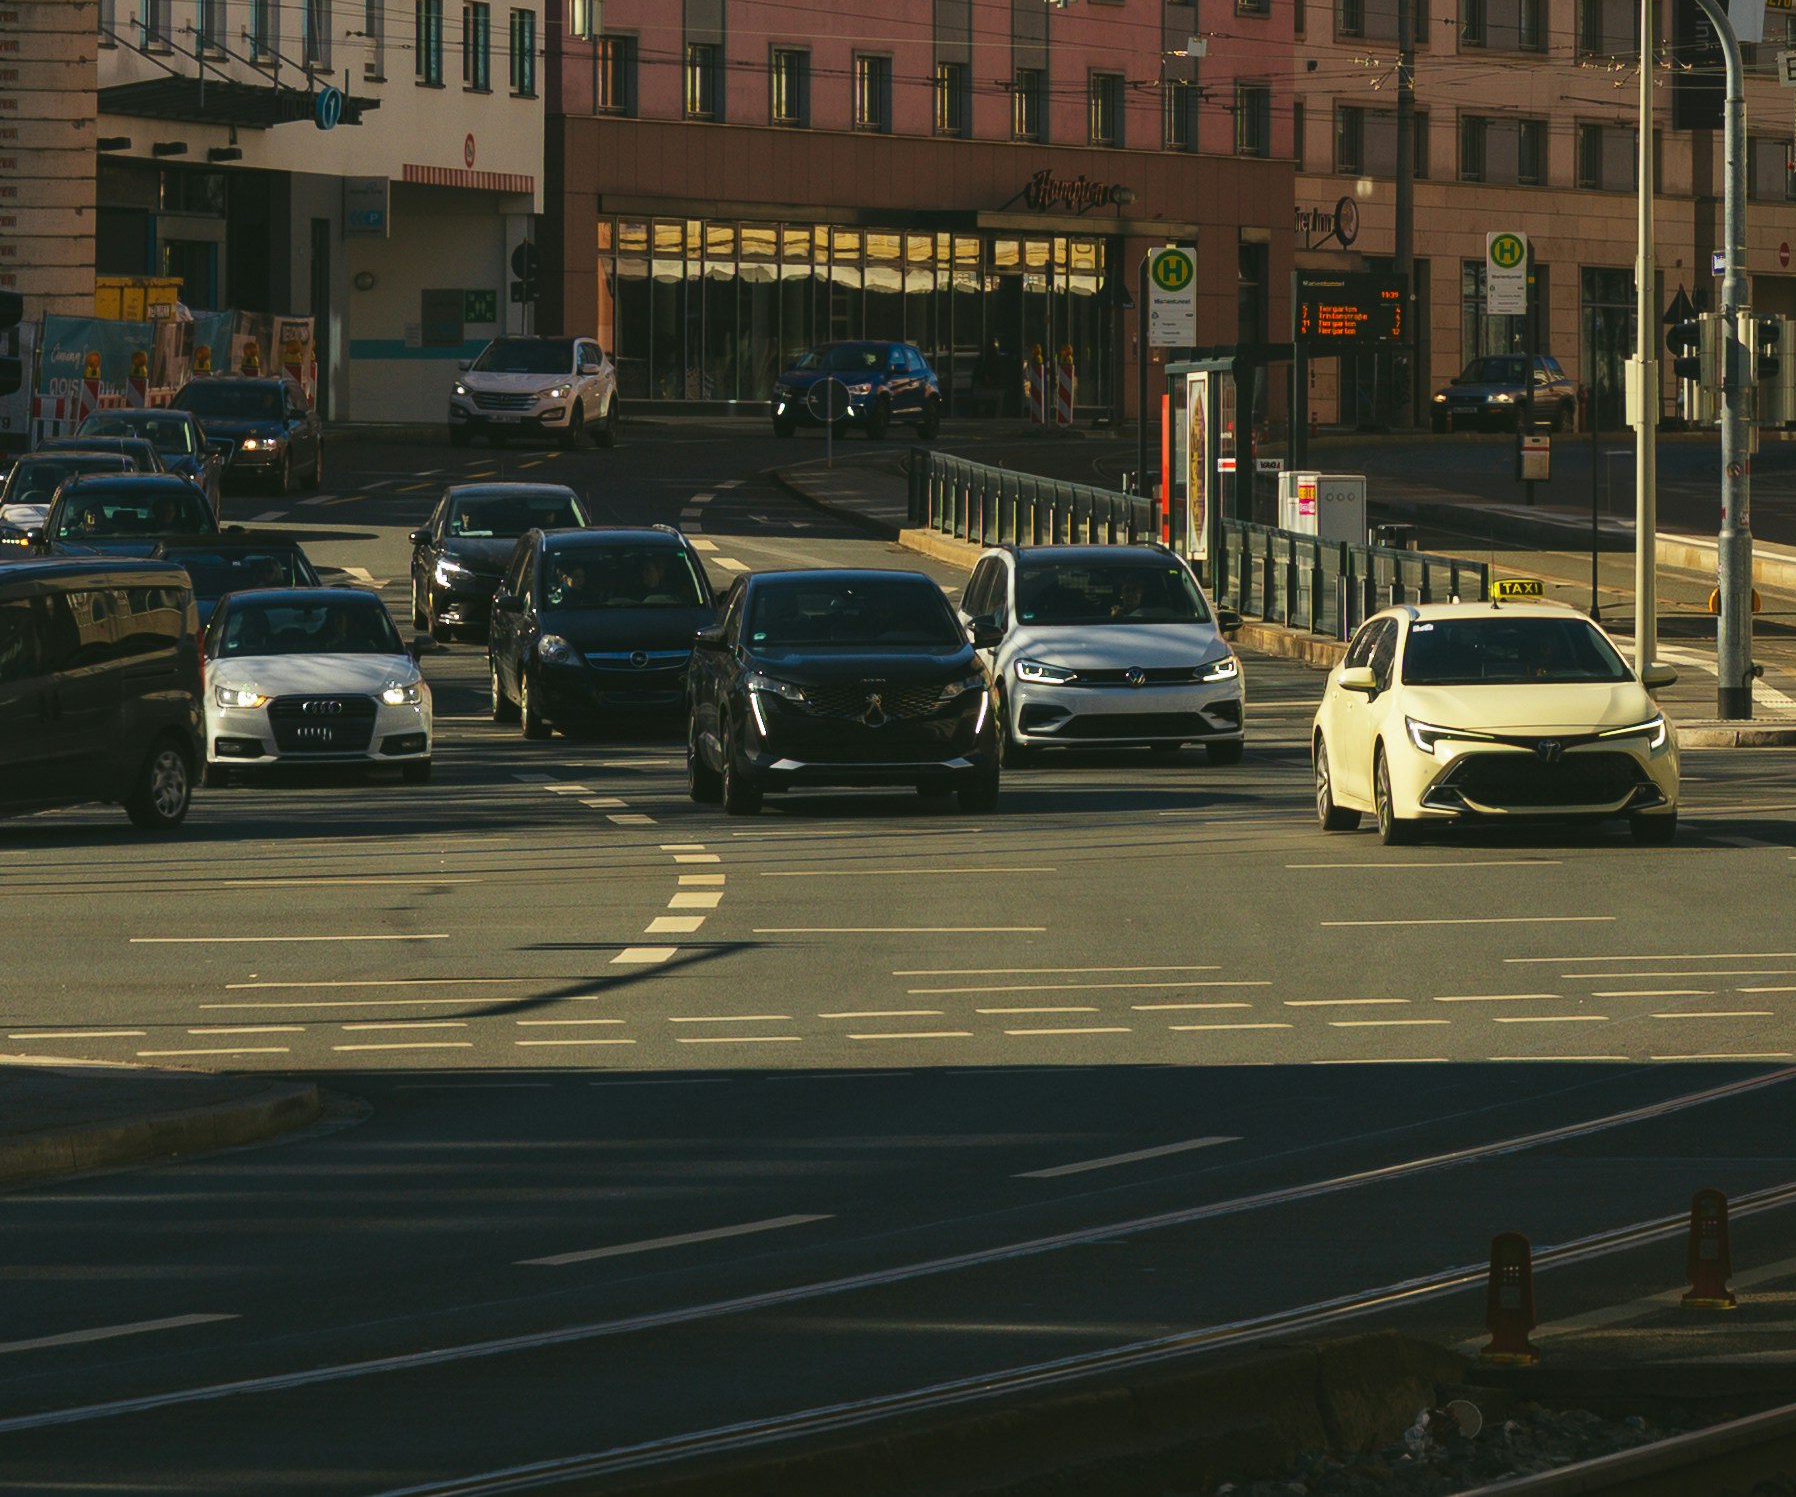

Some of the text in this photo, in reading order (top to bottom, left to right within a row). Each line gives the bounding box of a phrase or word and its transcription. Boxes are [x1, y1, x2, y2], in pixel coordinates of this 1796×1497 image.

[1499, 241, 1516, 261] H
[1163, 259, 1183, 282] H
[1503, 583, 1538, 594] TAXI
